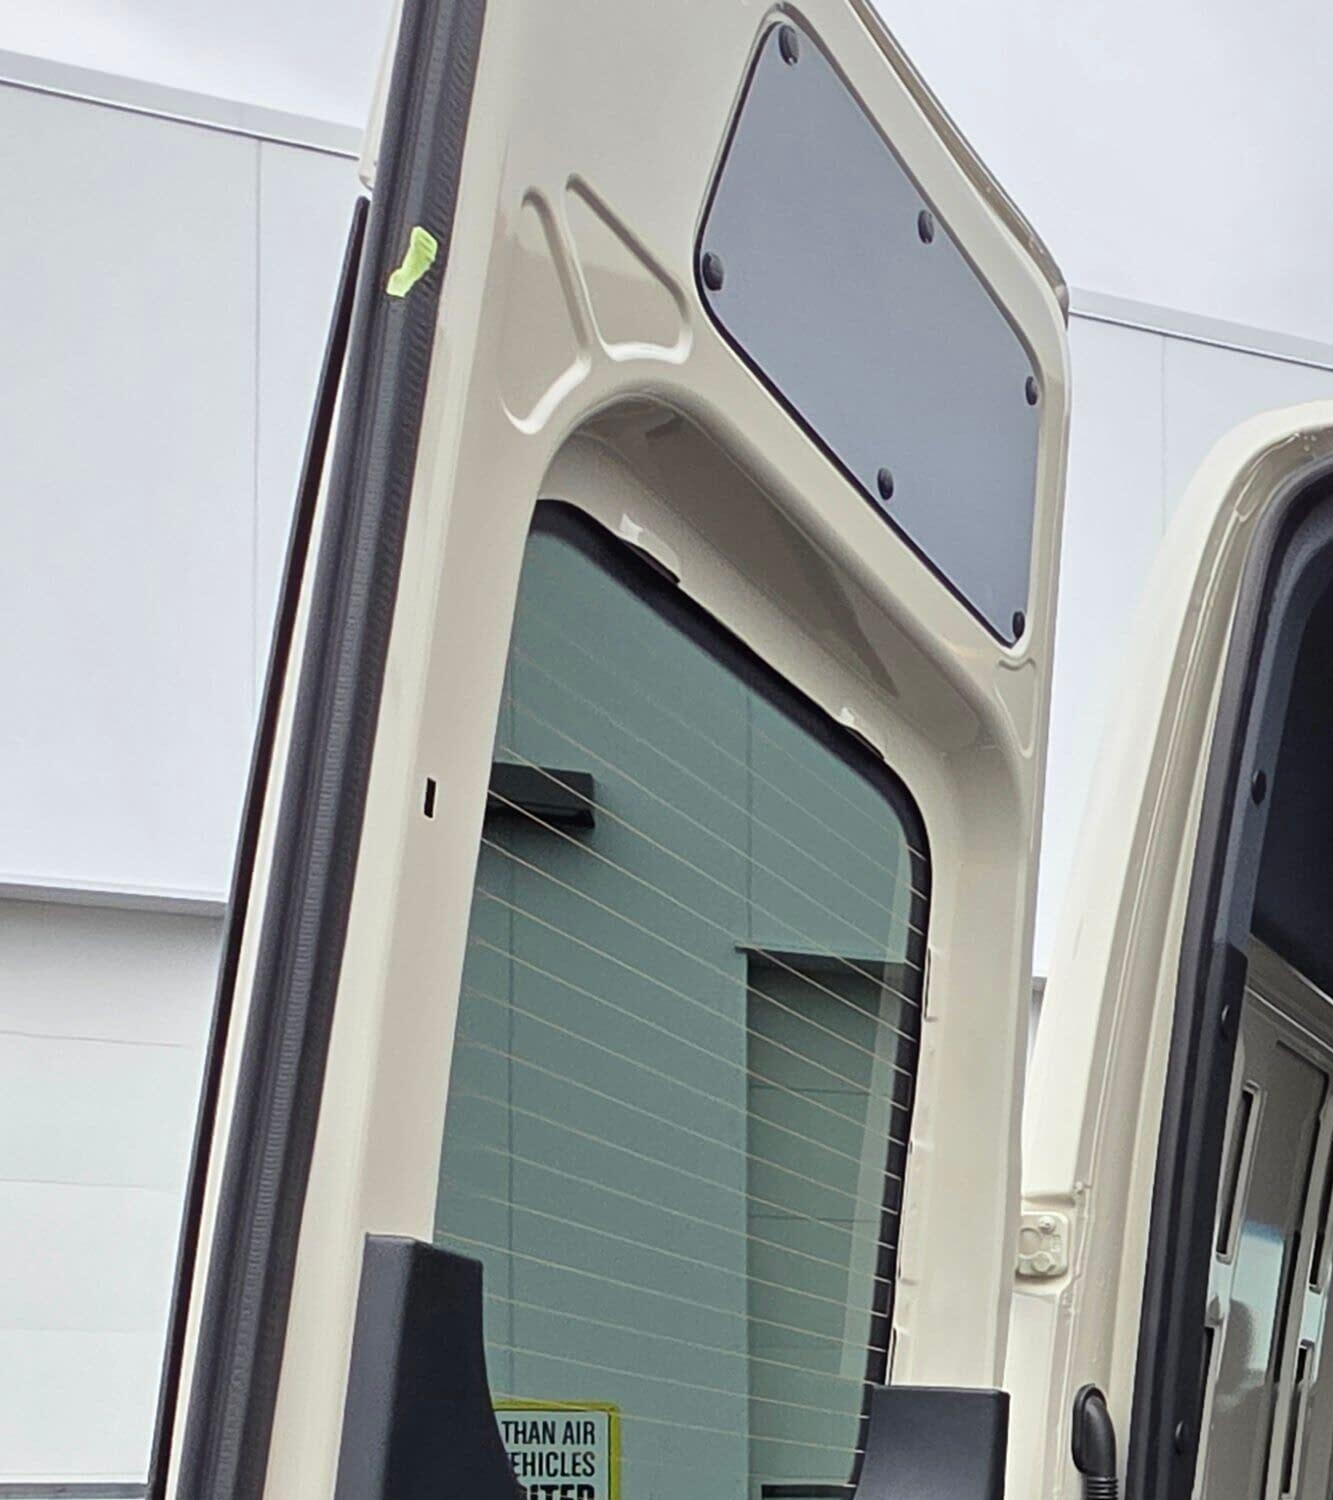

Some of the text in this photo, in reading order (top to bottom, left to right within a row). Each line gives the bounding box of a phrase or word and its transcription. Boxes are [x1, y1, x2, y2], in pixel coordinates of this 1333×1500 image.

[502, 1421, 595, 1445] THAN AIR
[507, 1452, 595, 1477] EHICLES
